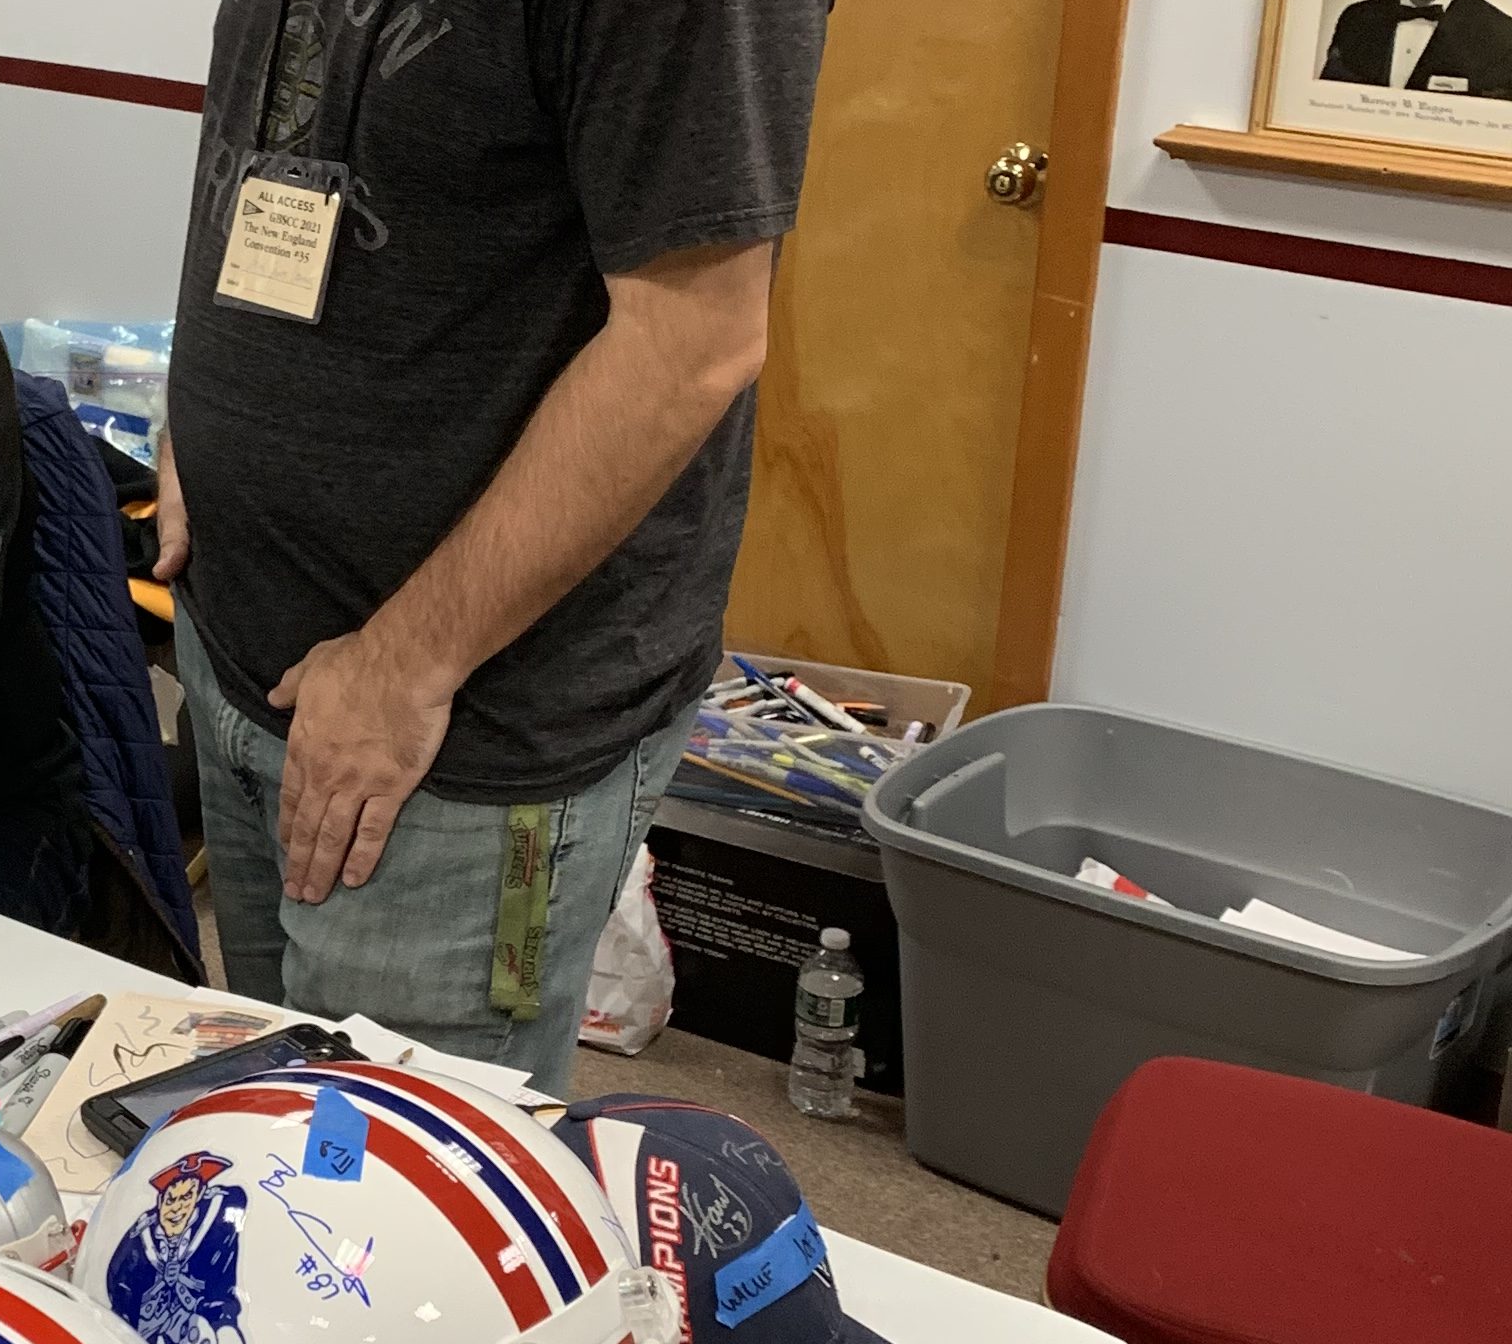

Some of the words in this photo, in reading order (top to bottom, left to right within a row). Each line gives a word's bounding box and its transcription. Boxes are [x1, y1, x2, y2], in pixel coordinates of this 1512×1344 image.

[258, 191, 275, 204] ALL
[277, 196, 316, 213] ACCESS
[269, 212, 299, 229] GBSCC
[300, 219, 322, 234] 2021
[244, 221, 258, 234] The
[262, 226, 278, 239] New
[281, 231, 318, 249] England
[244, 237, 291, 259] Convention
